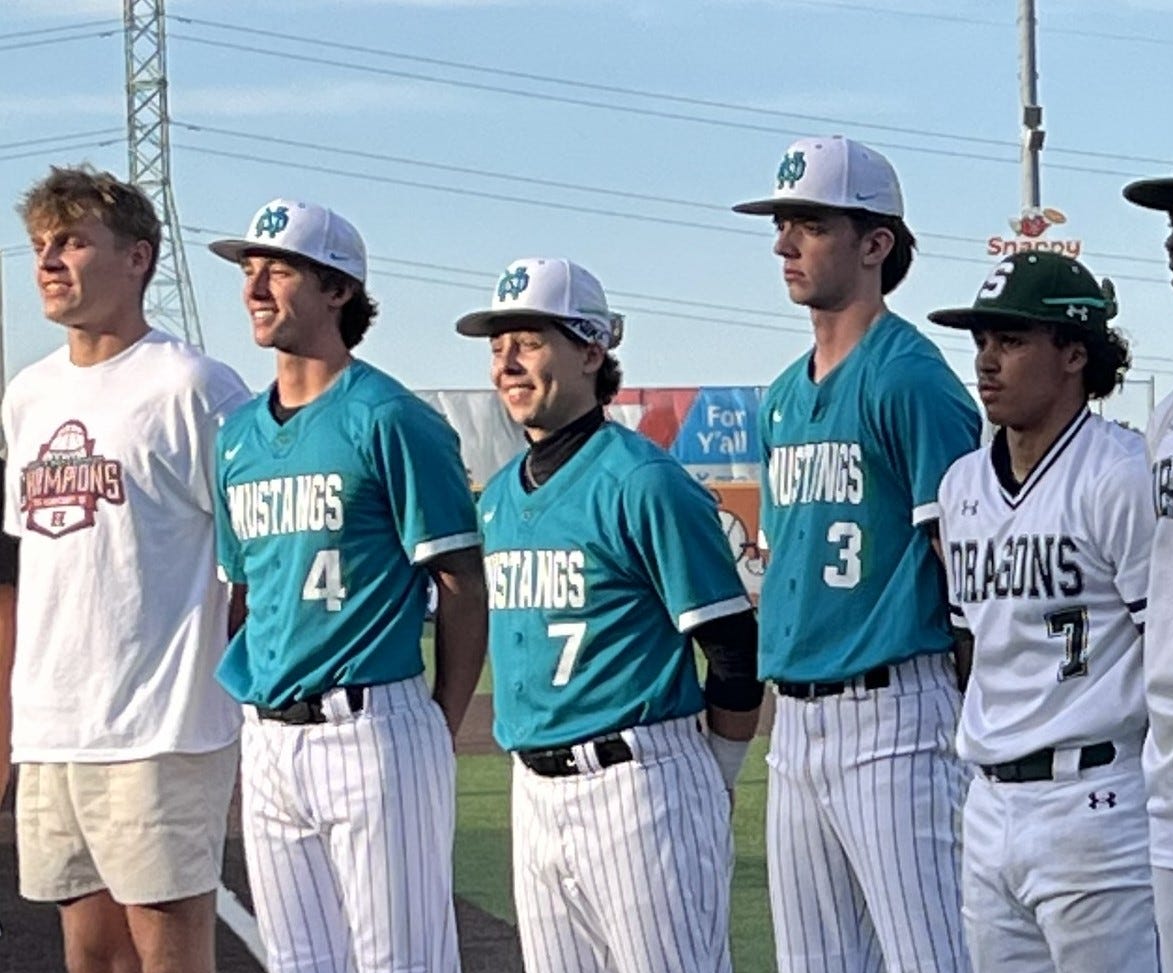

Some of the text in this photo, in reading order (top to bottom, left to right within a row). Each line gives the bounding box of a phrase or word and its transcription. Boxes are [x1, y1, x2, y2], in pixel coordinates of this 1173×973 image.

[979, 261, 1015, 299] S
[696, 430, 748, 456] Y'all
[706, 405, 746, 428] For
[226, 473, 345, 541] MUSTANGS
[302, 548, 347, 612] 4
[483, 550, 587, 610] STANGS
[822, 521, 863, 590] 3
[949, 534, 1086, 604] DRAGONS
[547, 621, 588, 687] 7
[1043, 605, 1090, 683] 7
